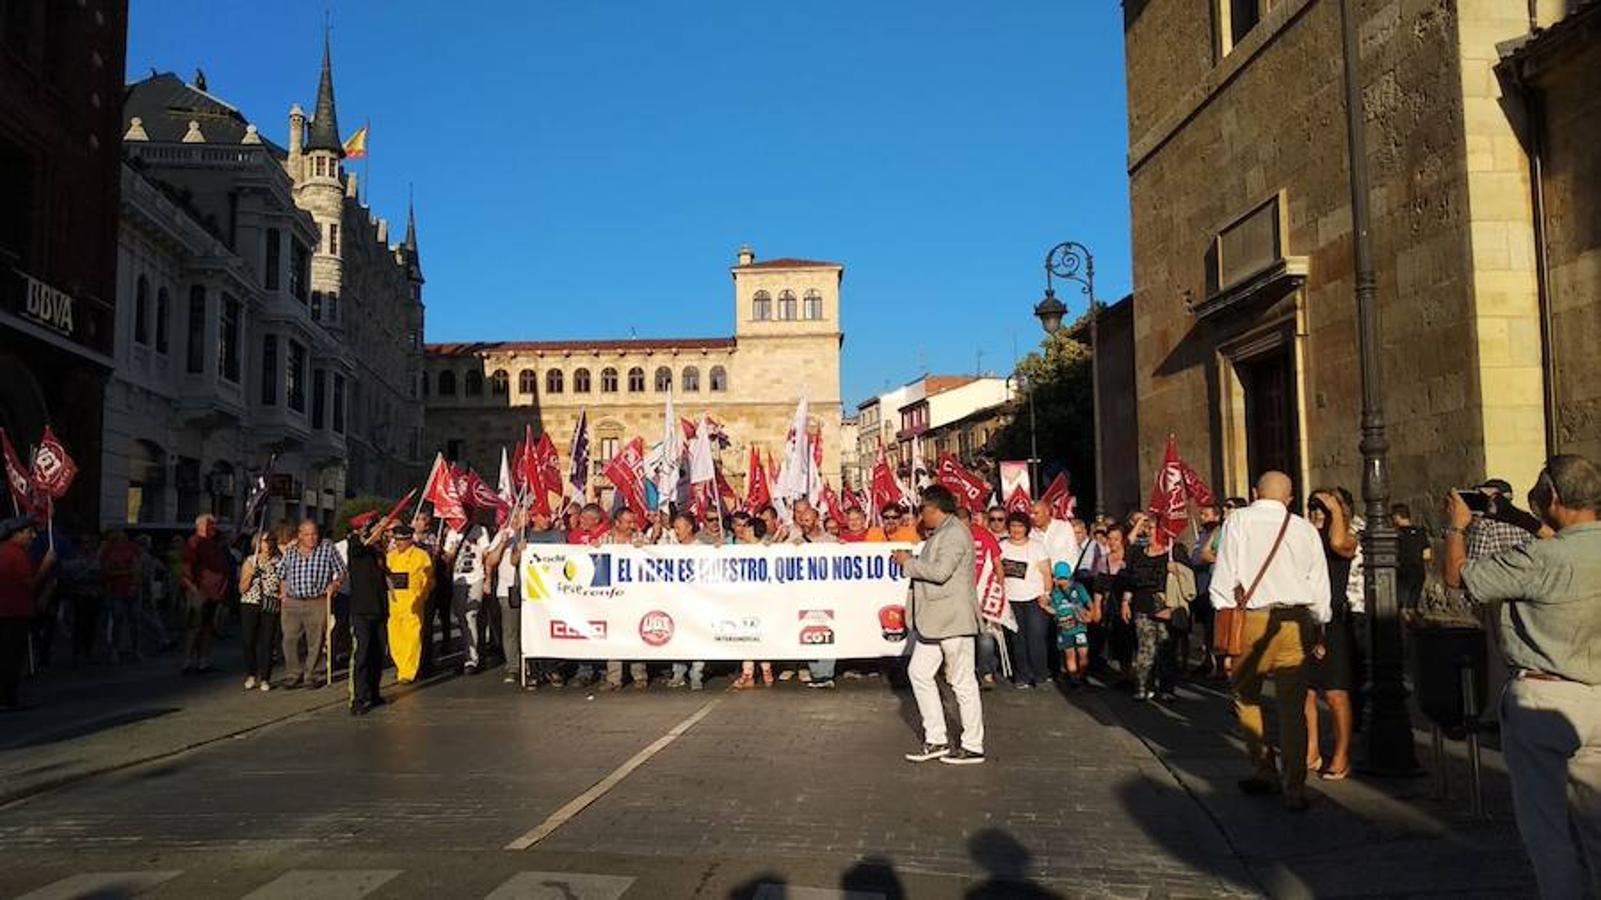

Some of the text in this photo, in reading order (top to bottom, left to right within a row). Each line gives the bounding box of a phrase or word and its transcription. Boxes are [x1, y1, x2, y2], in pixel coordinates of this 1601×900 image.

[27, 278, 73, 332] BBVA
[618, 557, 633, 582] EL
[679, 557, 695, 582] ES
[775, 556, 804, 583] QUE
[808, 556, 828, 582] NO
[833, 555, 863, 582] NOS
[867, 555, 883, 580] LO
[552, 621, 606, 638] CCO
[801, 631, 833, 643] CGT
